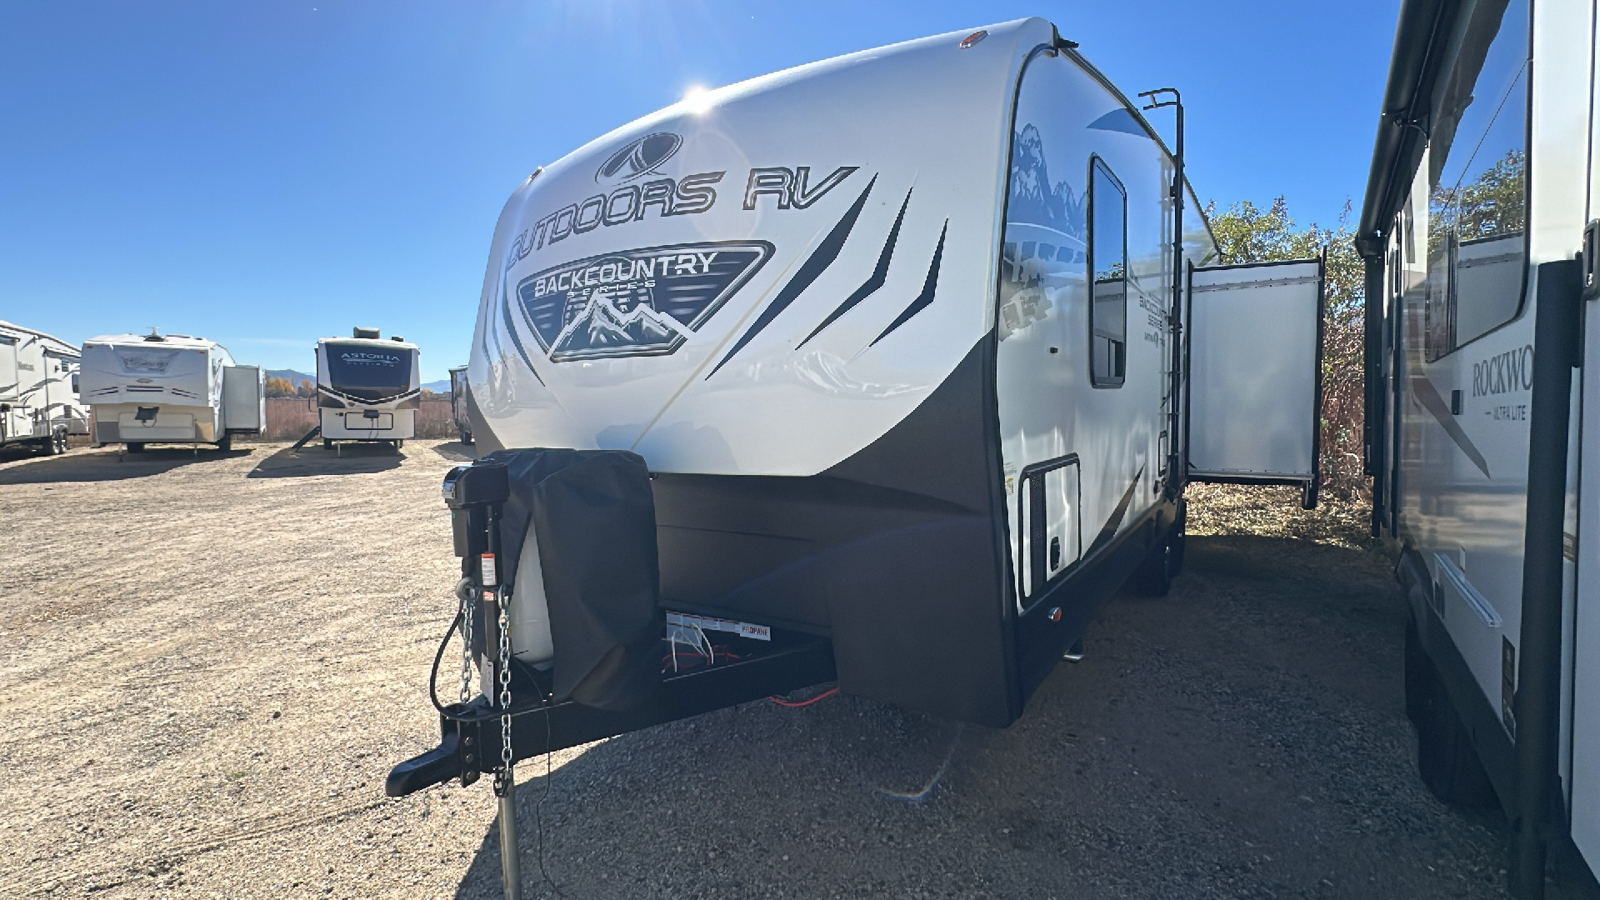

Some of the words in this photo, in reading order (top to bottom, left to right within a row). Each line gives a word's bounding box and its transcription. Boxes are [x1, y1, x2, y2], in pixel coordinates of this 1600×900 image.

[506, 170, 727, 270] OUTDOORS
[742, 166, 860, 211] RV
[534, 252, 718, 298] BACKCOUNTRY
[566, 279, 656, 299] SERIES
[341, 352, 401, 361] ASTORIA
[741, 625, 769, 637] PROPANE
